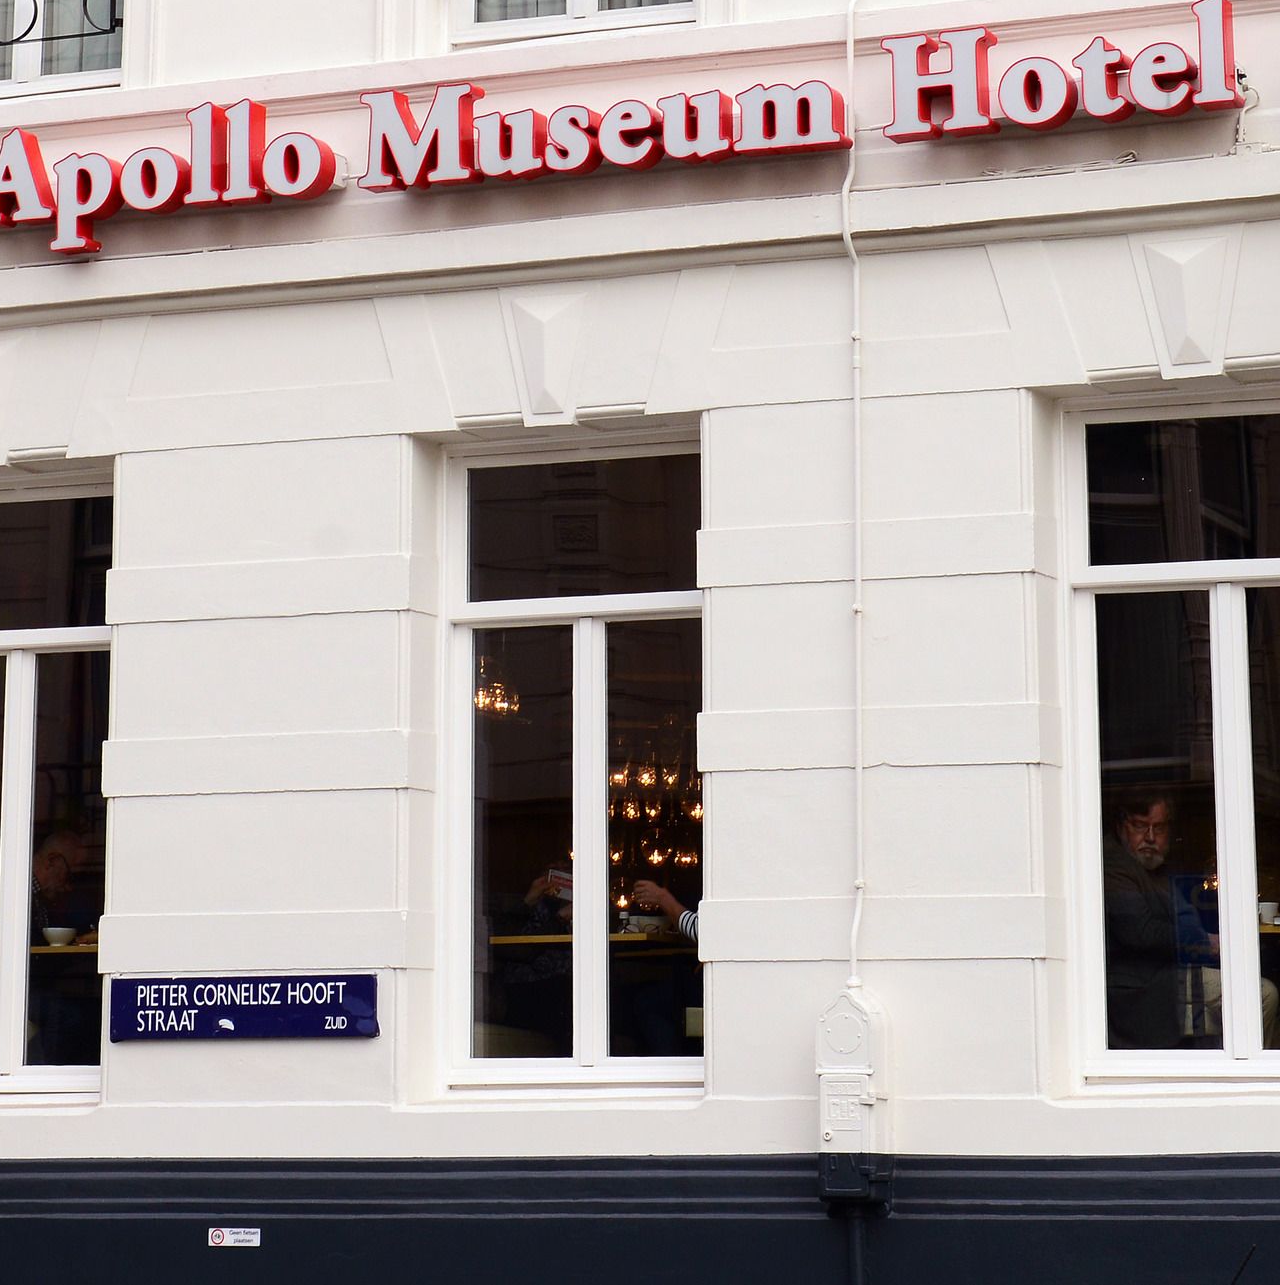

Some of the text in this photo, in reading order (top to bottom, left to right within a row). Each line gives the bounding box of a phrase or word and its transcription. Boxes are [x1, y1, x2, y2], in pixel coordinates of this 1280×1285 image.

[357, 80, 852, 193] Museum
[136, 982, 347, 1007] PIETER CORNELISZ HOOFT
[136, 1010, 198, 1032] STRAAT
[324, 1016, 348, 1030] ZUID
